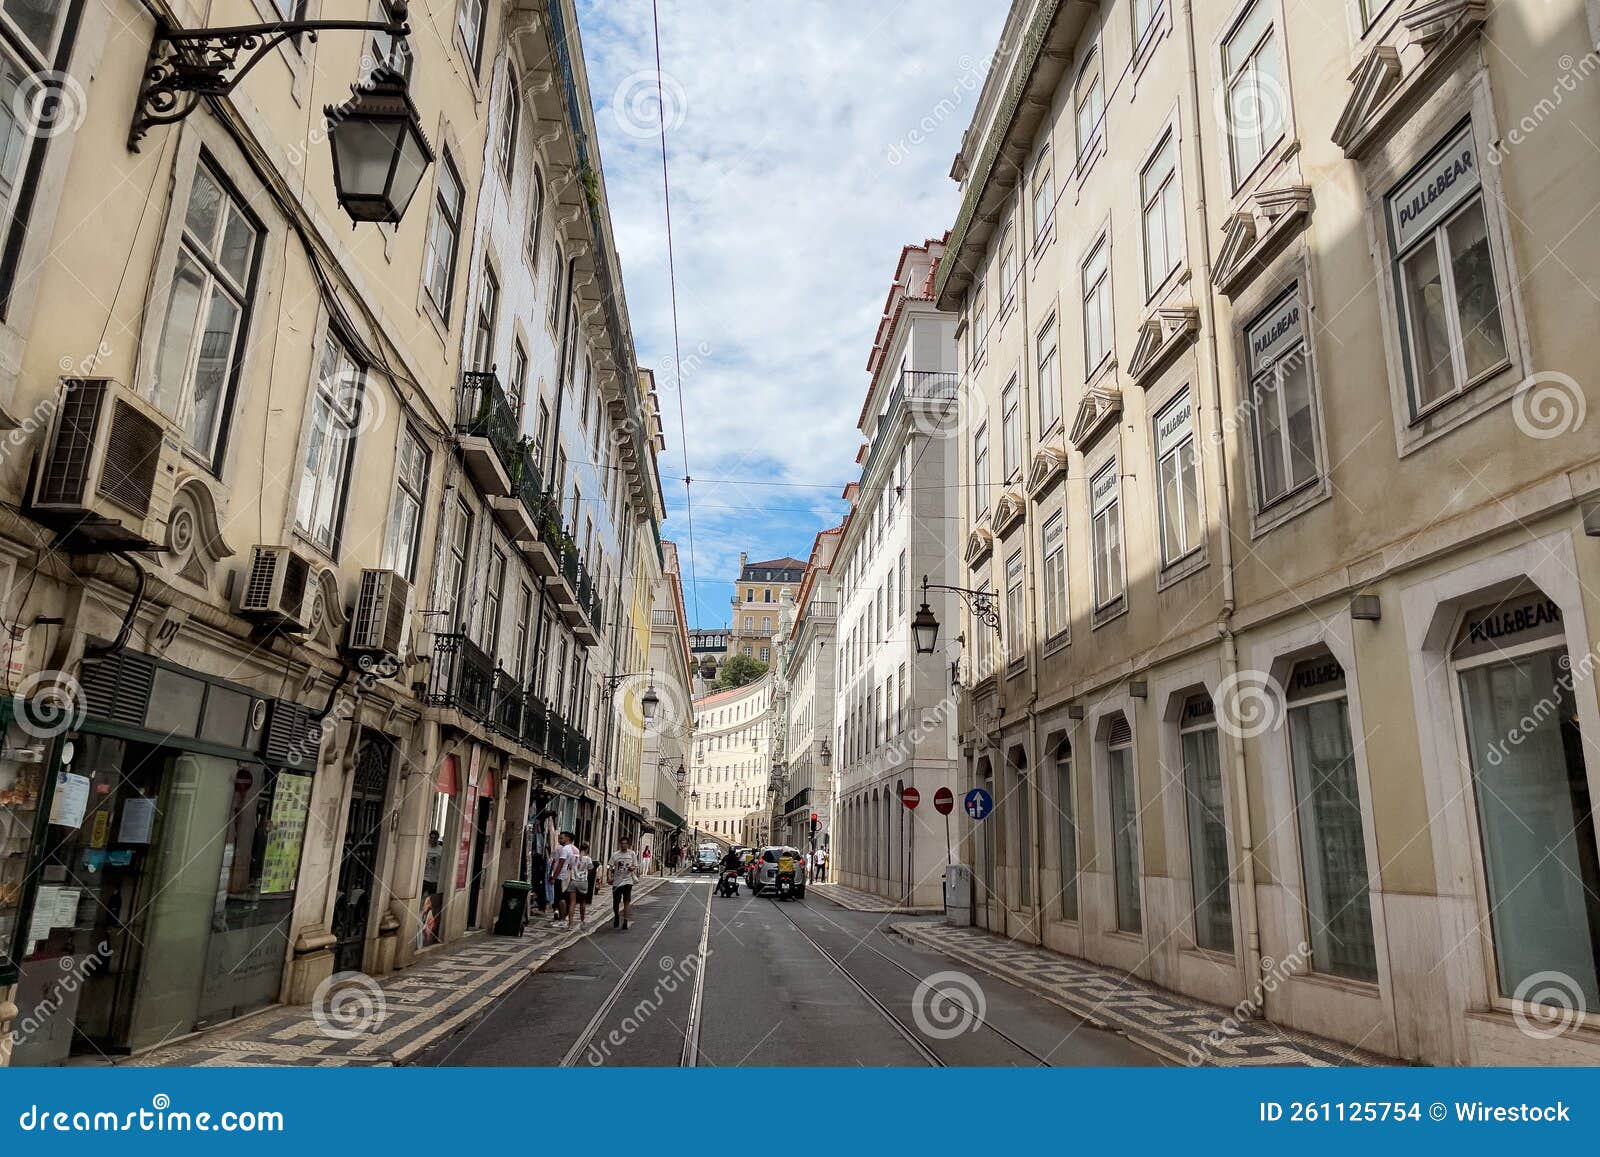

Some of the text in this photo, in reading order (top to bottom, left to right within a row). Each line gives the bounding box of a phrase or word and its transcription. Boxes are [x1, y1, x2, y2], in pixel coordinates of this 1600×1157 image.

[1400, 150, 1473, 229] PULL&BEAR
[1254, 307, 1300, 356] PULL&BEAR
[1160, 405, 1192, 440] PULL&BEAR
[1469, 601, 1560, 643] PULL&BEAR
